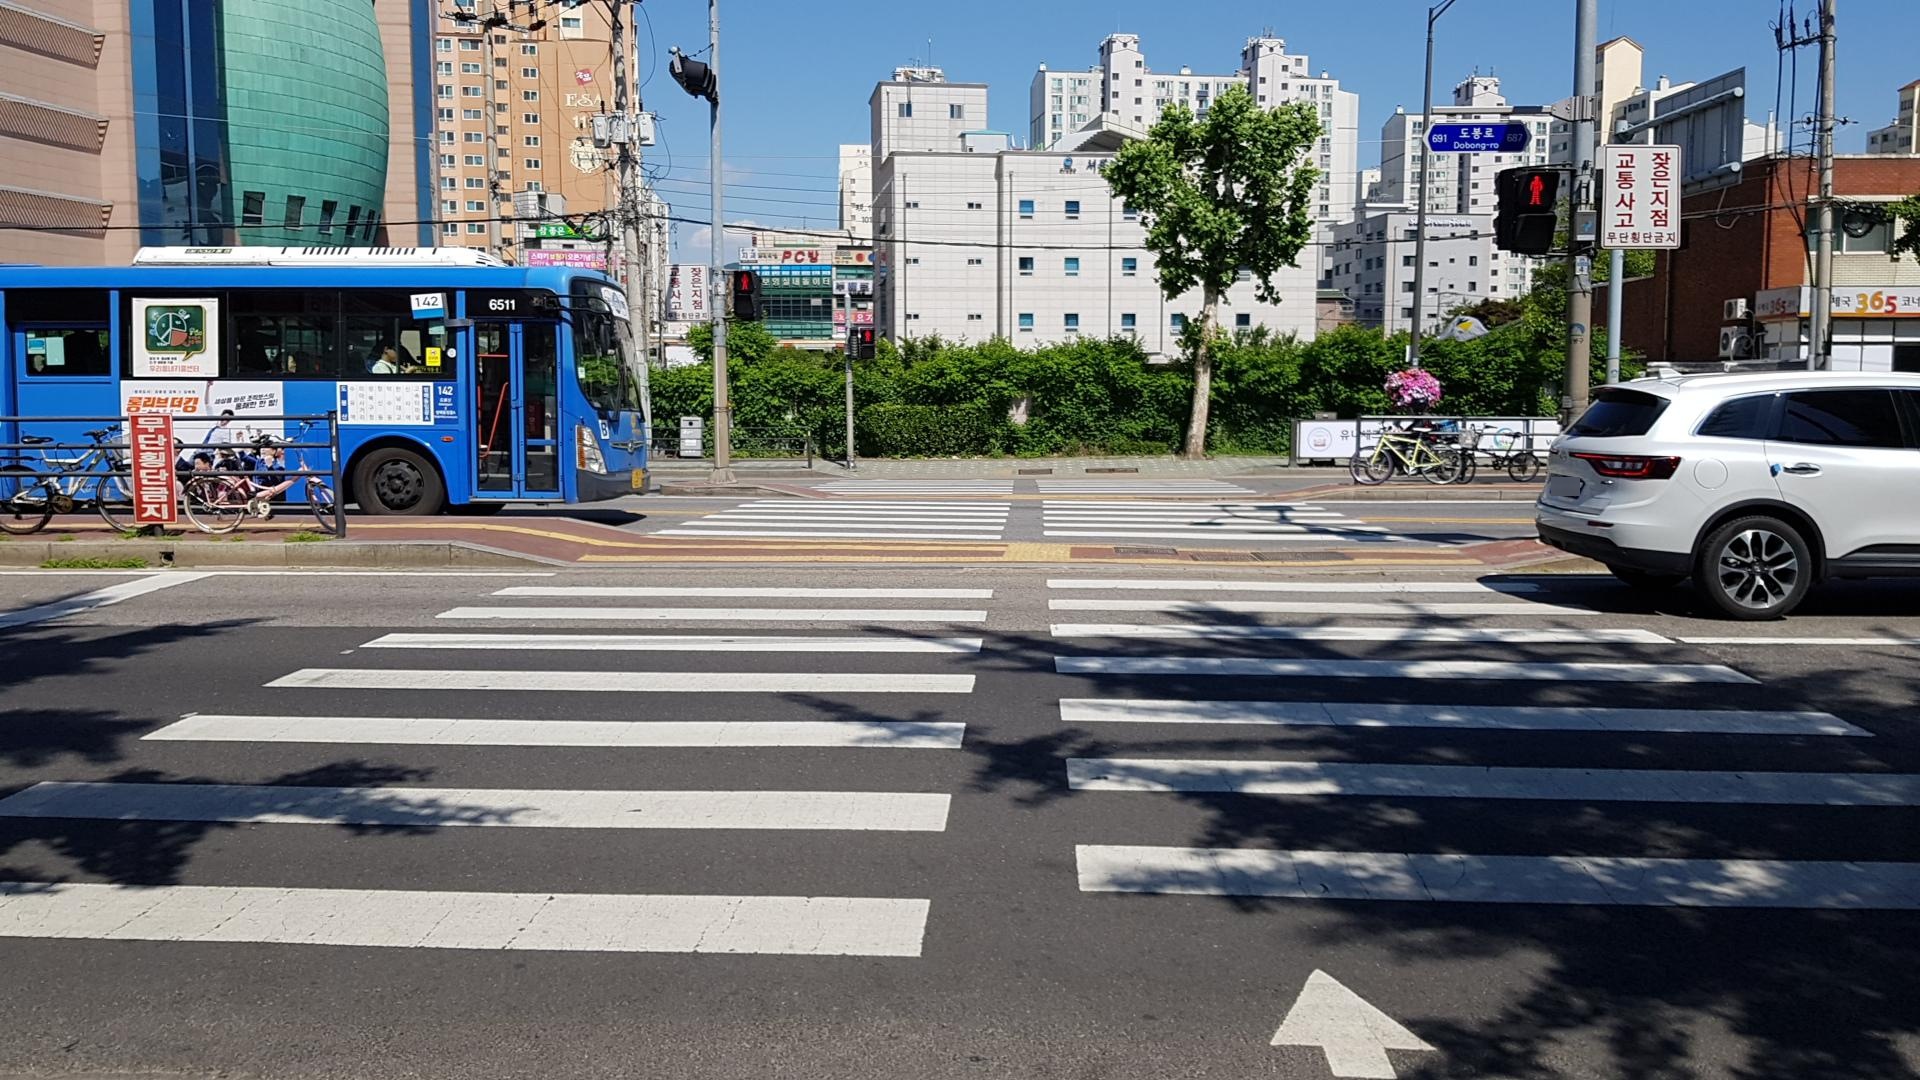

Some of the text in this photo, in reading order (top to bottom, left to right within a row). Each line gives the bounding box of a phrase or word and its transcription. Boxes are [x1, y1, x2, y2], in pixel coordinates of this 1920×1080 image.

[1432, 134, 1448, 143] 691
[1458, 127, 1495, 140] 도봉로
[1506, 133, 1523, 142] 687
[1453, 141, 1500, 150] Dobong-ro
[1614, 153, 1636, 228] 교통사고
[1650, 152, 1671, 228] 잦은지점
[1607, 231, 1676, 244] 무단횡단금지
[781, 250, 820, 264] PC방
[691, 267, 703, 310] 잦은지점
[415, 296, 439, 307] 142
[488, 299, 516, 311] 6511
[1854, 291, 1898, 315] 365
[437, 386, 454, 396] 142
[136, 417, 169, 520] 무단횡단금지
